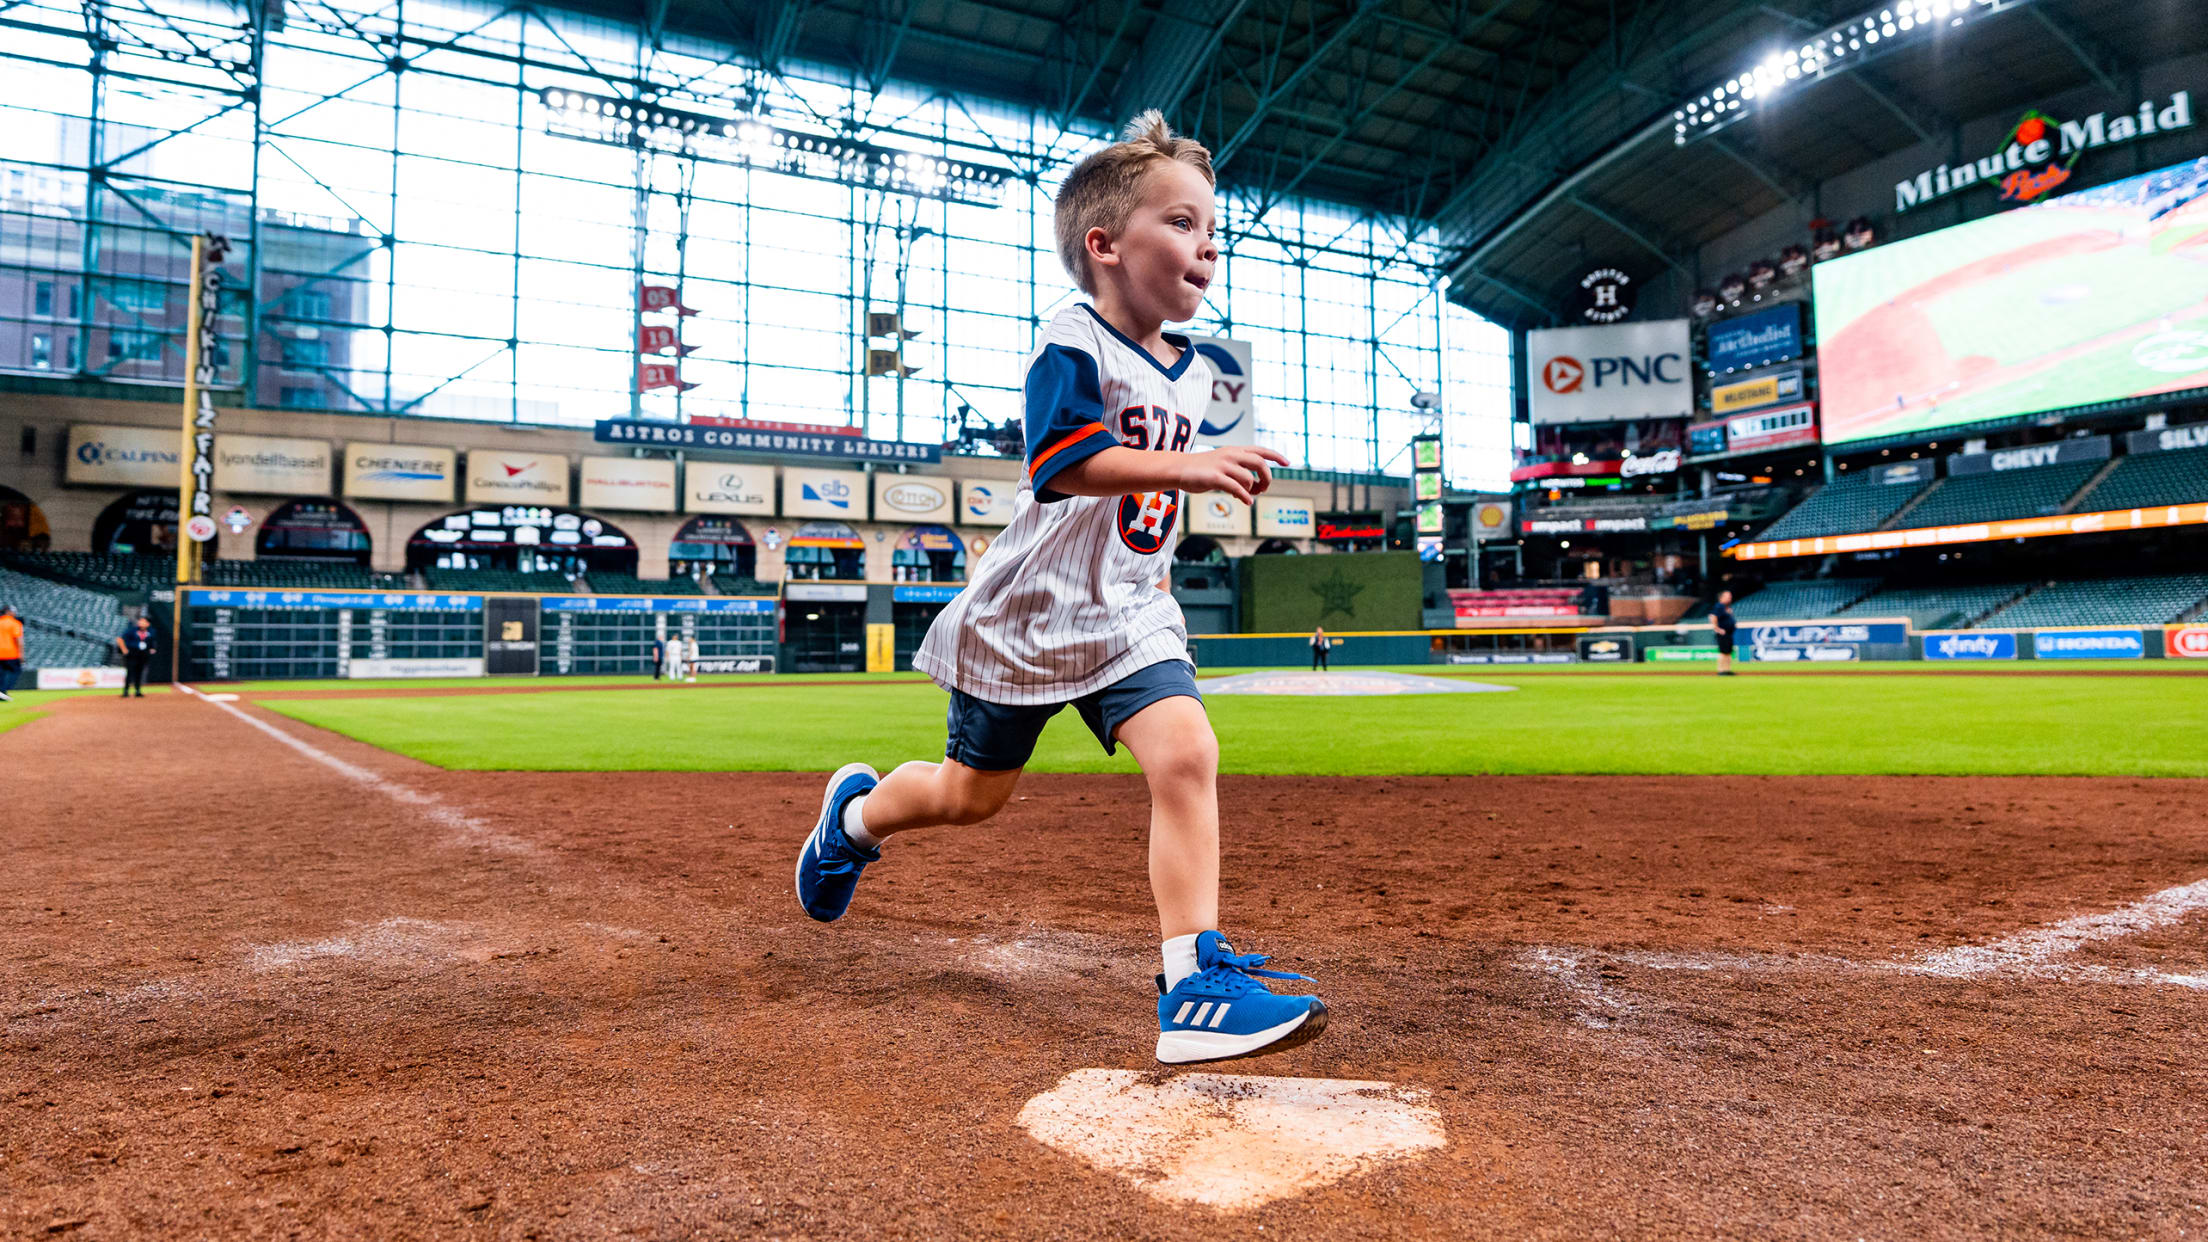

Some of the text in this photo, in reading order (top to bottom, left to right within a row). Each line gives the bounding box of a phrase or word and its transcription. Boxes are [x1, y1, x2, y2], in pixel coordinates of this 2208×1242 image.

[1895, 90, 2193, 213] Minute Maid
[1595, 285, 1618, 307] H
[649, 330, 670, 345] 19
[647, 368, 667, 383] 21
[1591, 354, 1682, 388] PNC
[610, 424, 929, 459] ASTROS COMMUNITY LEADERS
[356, 456, 446, 472] CHENIERE
[1991, 445, 2060, 471] CHEVY
[696, 492, 764, 504] LEXUS
[1129, 491, 1173, 537] H
[2056, 636, 2141, 651] HONDA
